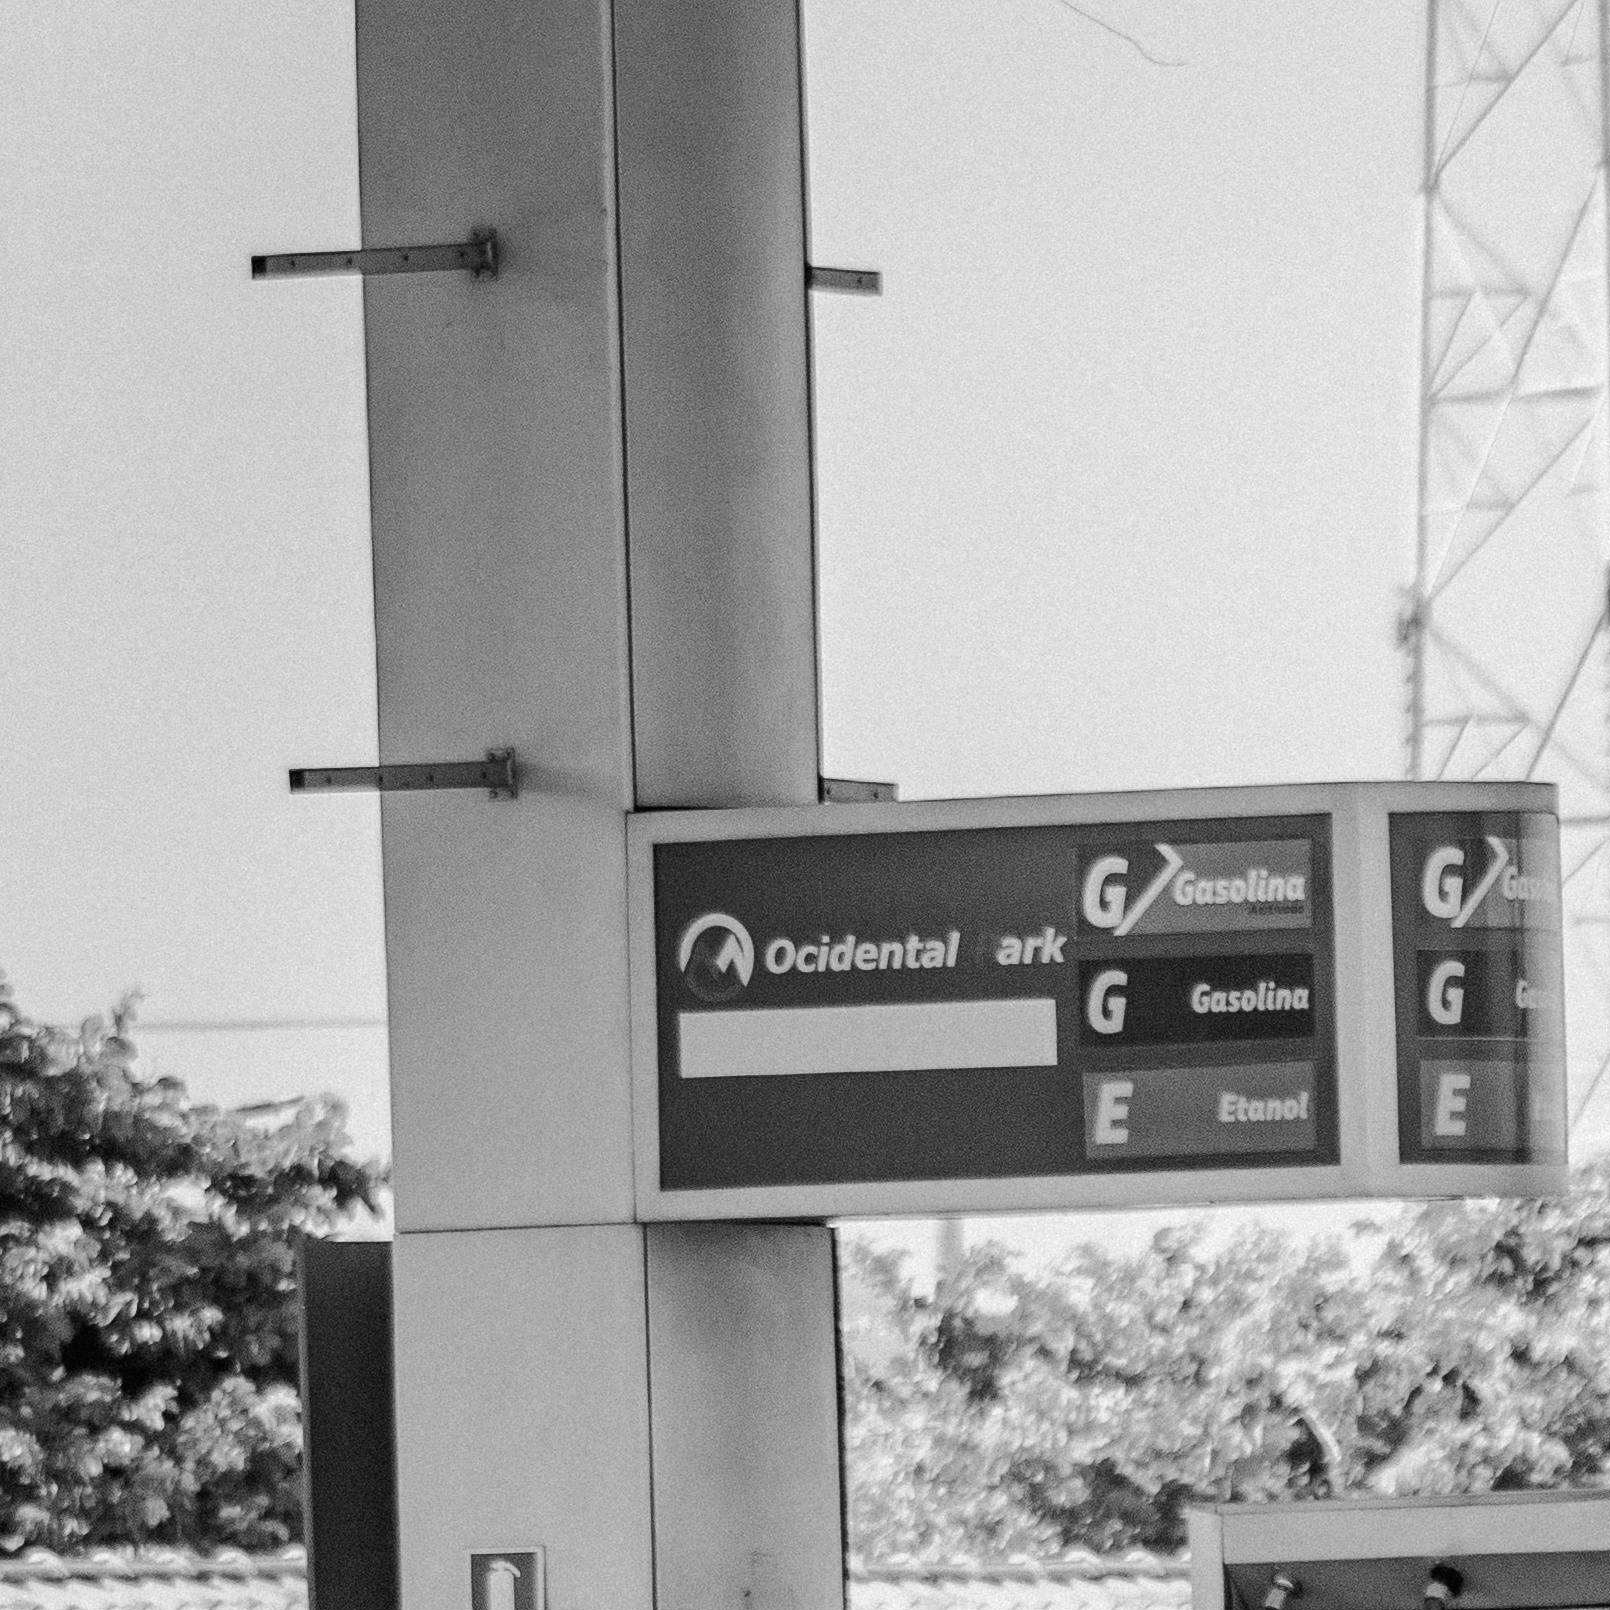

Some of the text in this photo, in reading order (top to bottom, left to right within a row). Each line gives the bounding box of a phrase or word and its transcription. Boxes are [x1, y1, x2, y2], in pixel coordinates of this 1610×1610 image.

[1173, 868, 1305, 905] Gasolina
[765, 931, 960, 974] Ocidental
[1086, 969, 1309, 1034] G Gasolina
[1427, 961, 1466, 1025] G
[1095, 1080, 1309, 1145] E Etanol
[1434, 1073, 1472, 1137] E
